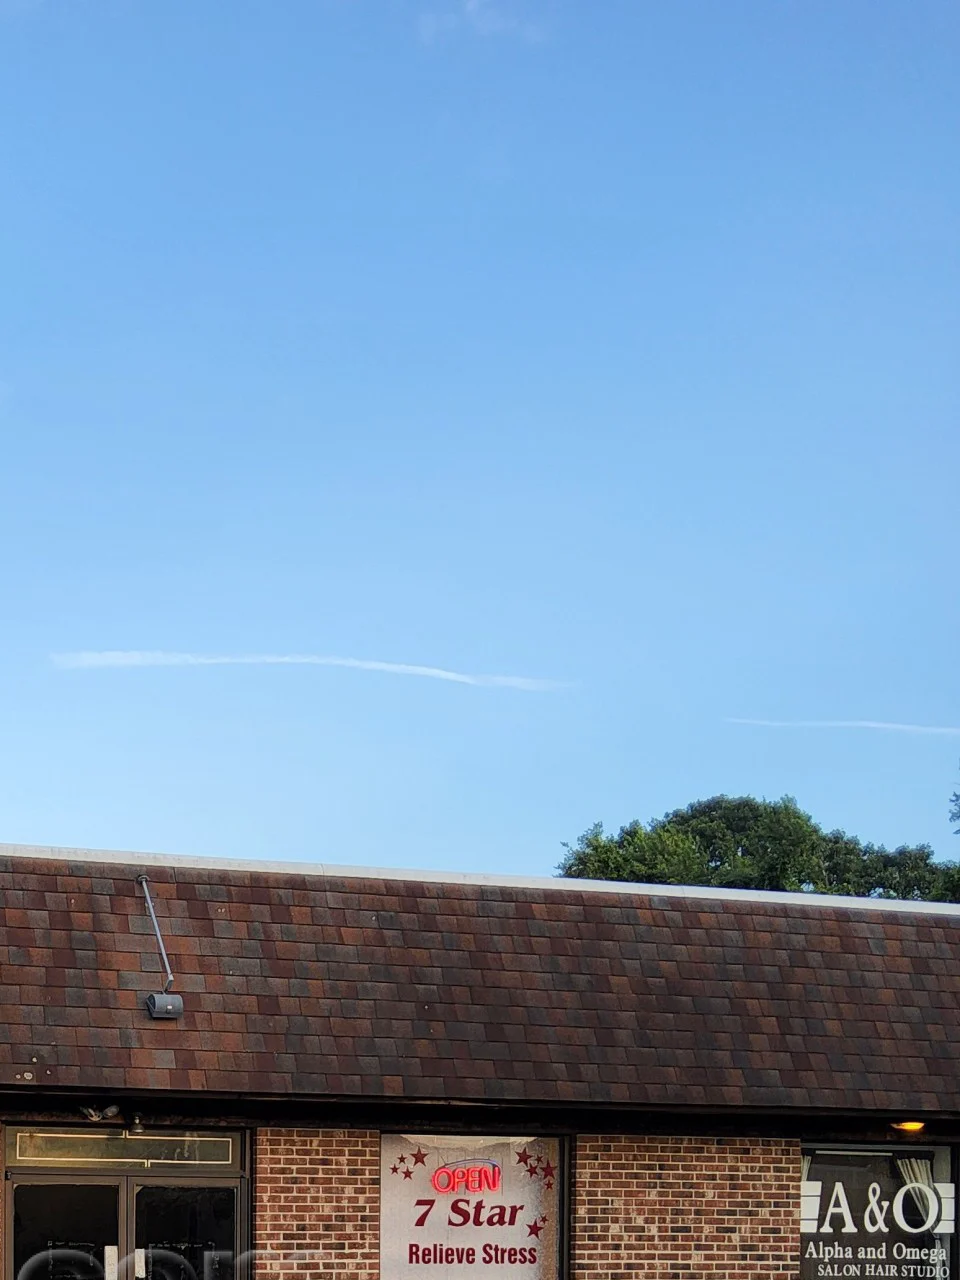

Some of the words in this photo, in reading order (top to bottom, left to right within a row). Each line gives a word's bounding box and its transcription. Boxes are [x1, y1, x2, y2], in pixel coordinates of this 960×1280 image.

[431, 1165, 501, 1193] OPEN
[413, 1199, 436, 1227] 7
[448, 1198, 525, 1227] Star
[408, 1243, 476, 1265] Relieve
[482, 1243, 537, 1265] Stress
[804, 1241, 853, 1262] Alpha
[858, 1242, 886, 1259] and
[893, 1242, 947, 1263] Omega
[817, 1264, 861, 1276] SALON
[865, 1264, 898, 1277] HAIR
[901, 1265, 950, 1278] STUDIO
